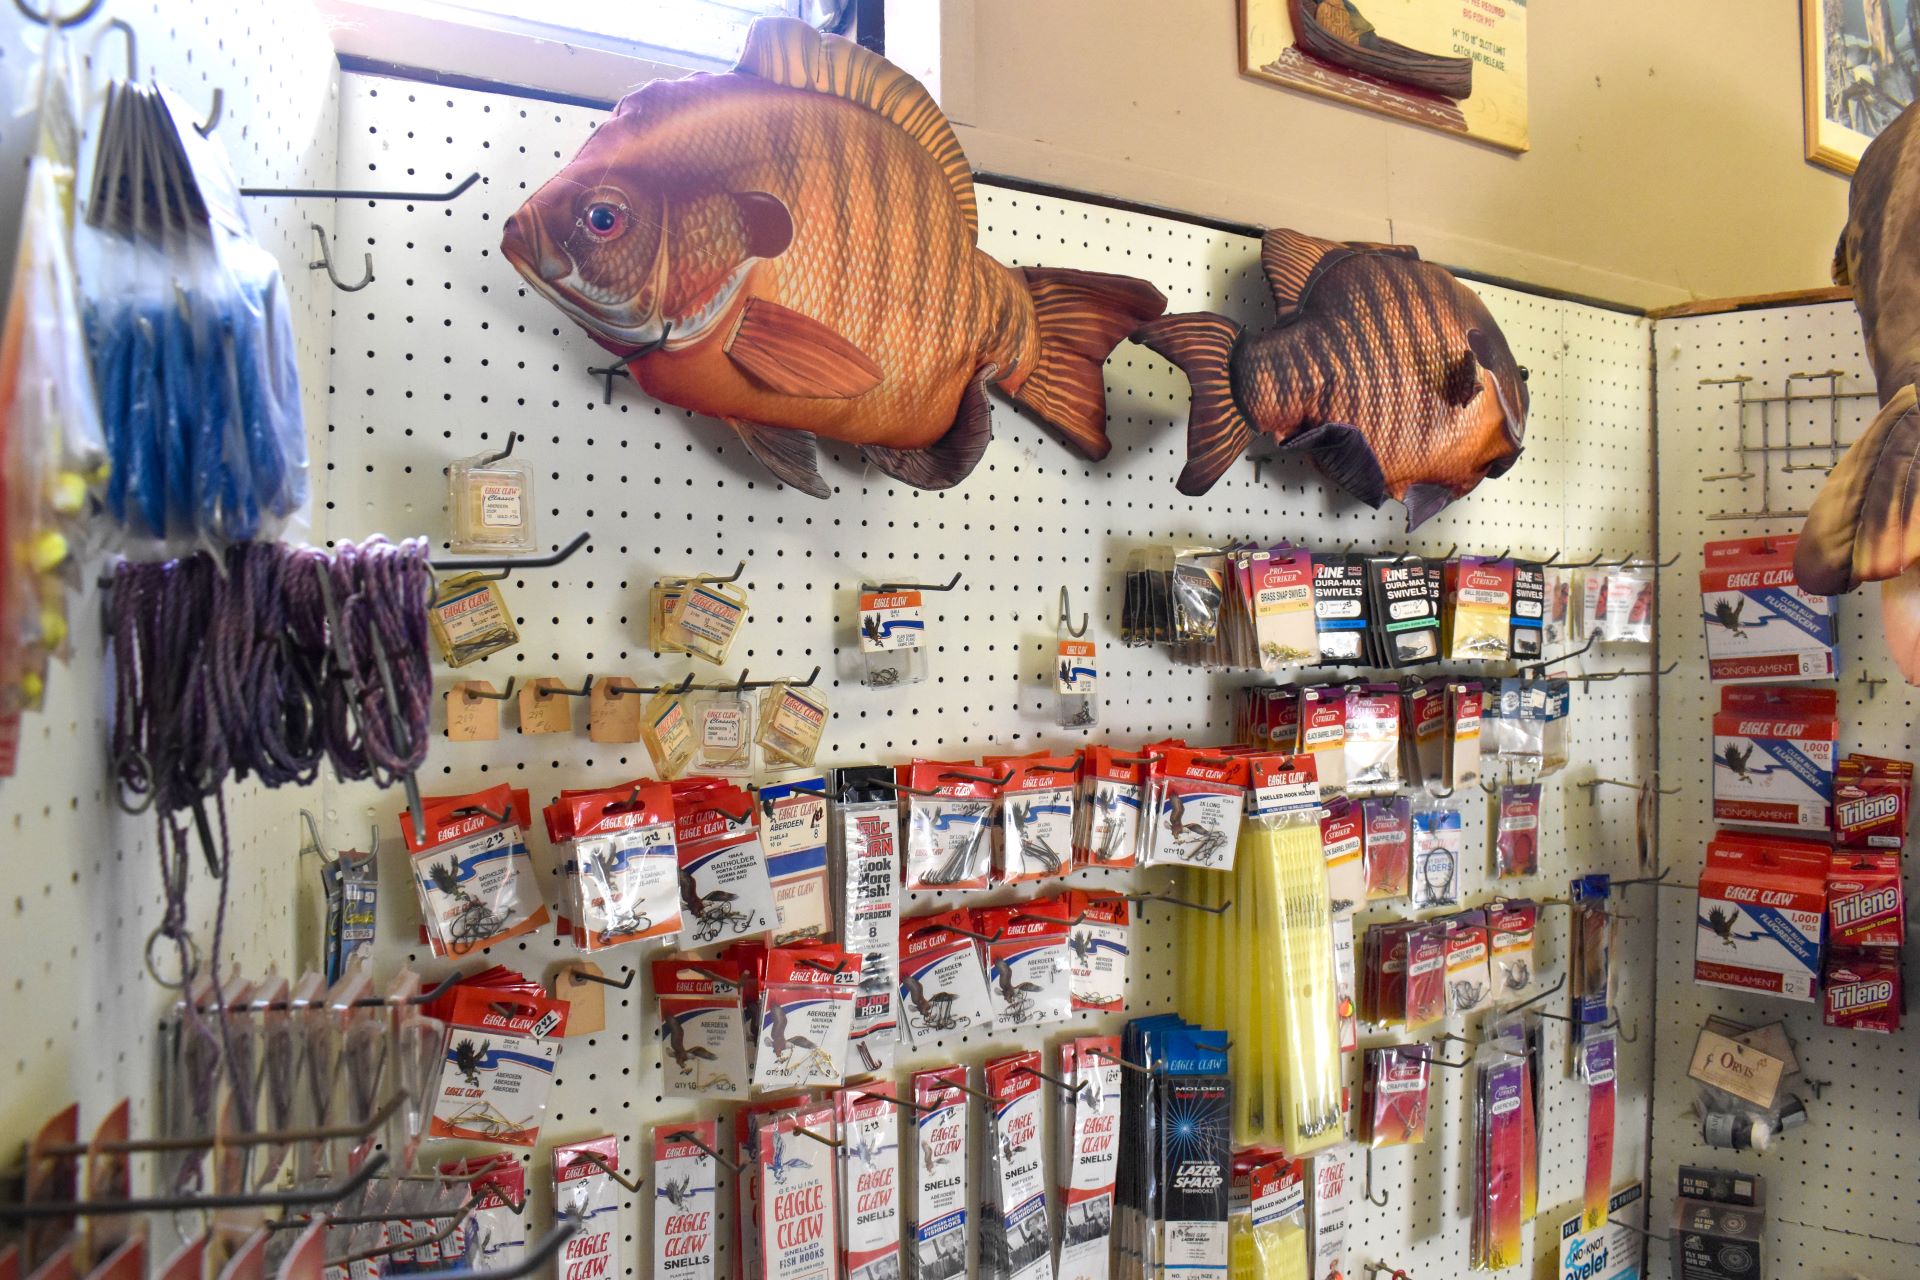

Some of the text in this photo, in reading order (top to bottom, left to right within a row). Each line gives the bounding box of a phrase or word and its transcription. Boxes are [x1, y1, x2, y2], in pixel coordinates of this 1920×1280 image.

[1462, 31, 1469, 42] TO
[1453, 44, 1504, 71] CATCH AND RELEASE
[1268, 575, 1297, 587] STRIKER
[1315, 579, 1362, 587] DURA-MAX
[1385, 579, 1426, 590] DURA-MAX
[1727, 569, 1793, 588] EAGLE CLAW
[1260, 587, 1307, 603] BRASS SNAP SWIVELS
[1315, 588, 1363, 598] SWIVELS
[1387, 587, 1428, 600] SWIVELS
[1515, 589, 1543, 600] SWIVELS
[443, 592, 491, 620] EAGLE CLAW
[691, 594, 715, 612] EAGLE
[714, 605, 738, 621] CLAW
[1764, 595, 1822, 633] FLUORESCENT
[1779, 596, 1815, 620] CLEAR BLUE
[1711, 663, 1794, 676] MONOFILAMENT
[1802, 662, 1809, 672] 6
[1738, 721, 1805, 737] EAGLE CLAW
[1803, 742, 1830, 753] 1,000
[1186, 767, 1223, 780] EAGLE CLAW
[1772, 745, 1824, 787] FLUORESCENT
[1022, 777, 1055, 789] EAGLE CLAW
[1267, 772, 1305, 788] EAGLE CLAW
[1259, 790, 1315, 802] SNELLED HOOK HOLDER
[779, 802, 821, 823] EAGLE CLAW
[1715, 807, 1793, 821] MONOFILAMENT
[1838, 795, 1896, 826] Trilene
[437, 815, 485, 843] EAGLE CLAW
[600, 813, 645, 835] EAGLE CLAW
[679, 818, 725, 844] EAGLE CLAW
[770, 819, 804, 833] ABERDEEN
[711, 856, 755, 871] BAITHOLDER
[715, 861, 757, 875] PORTA CARNADA
[1724, 886, 1794, 906] EAGLE CLAW
[1831, 888, 1897, 927] Trilene
[1791, 912, 1819, 924] 1,000
[869, 927, 878, 939] 8
[1007, 922, 1045, 936] EAGLE CLAW
[1759, 913, 1810, 959] FLUORESCENT
[1844, 928, 1853, 936] XL
[908, 933, 947, 954] EAGLE CLAW
[934, 962, 962, 976] ABERDEEN
[1027, 957, 1055, 966] ABERDEEN
[789, 970, 832, 983] EAGLE CLAW
[1696, 969, 1777, 988] MONOFILAMENT
[676, 982, 713, 992] EAGLE CLAW
[1785, 983, 1793, 993] 12
[1831, 982, 1890, 1009] Trilene
[807, 1010, 837, 1018] ABERDEEN
[861, 1005, 882, 1018] RED
[482, 1014, 533, 1030] EAGLE CLAW
[701, 1021, 728, 1029] ABERDEEN
[1170, 1058, 1222, 1071] EAGLE CLAW
[1720, 1052, 1754, 1079] ORVIS
[493, 1078, 521, 1087] ABERDEEN
[495, 1071, 522, 1080] ABERDEEN
[444, 1086, 484, 1098] EAGLE CLAW
[491, 1084, 519, 1093] ABERDEEN
[687, 1081, 697, 1090] 10
[731, 1084, 736, 1092] 6
[1001, 1078, 1033, 1097] EAGLE CLAW
[1008, 1112, 1033, 1133] EAGLE
[1082, 1115, 1113, 1134] EAGLE
[930, 1125, 960, 1143] EAGLE
[1011, 1127, 1037, 1147] CLAW
[665, 1146, 686, 1158] EAGLE
[933, 1139, 962, 1157] CLAW
[1081, 1134, 1113, 1154] CLAW
[1080, 1153, 1113, 1165] SNELLS
[565, 1166, 587, 1180] EAGLE
[1005, 1161, 1039, 1181] SNELLS
[1176, 1165, 1221, 1177] LAZER
[1318, 1162, 1345, 1185] EAGLE
[778, 1178, 820, 1195] GENUINE
[856, 1167, 894, 1192] EAGLE
[924, 1176, 961, 1193] SNELLS
[1173, 1176, 1223, 1189] SHARP
[1262, 1173, 1295, 1197] EAGLE CLAW
[1683, 1177, 1709, 1189] FLY REEL
[774, 1185, 824, 1222] EAGLE
[857, 1188, 893, 1213] CLAW
[930, 1191, 956, 1201] ABERDEEN
[1254, 1201, 1274, 1213] SNELLED
[1287, 1190, 1301, 1200] HOLDER
[665, 1211, 710, 1236] EAGLE
[856, 1208, 895, 1225] SNELLS
[777, 1213, 823, 1250] CLAW
[1319, 1221, 1344, 1236] SNELLS
[1564, 1221, 1576, 1235] FLY
[566, 1231, 610, 1260] EAGLE
[664, 1233, 709, 1258] CLAW
[784, 1242, 819, 1258] SNELLED
[664, 1255, 710, 1270] SNELLS
[779, 1248, 825, 1269] FISH HOOKS
[1685, 1250, 1712, 1262] FLY REEL
[566, 1255, 609, 1280] CLAW
